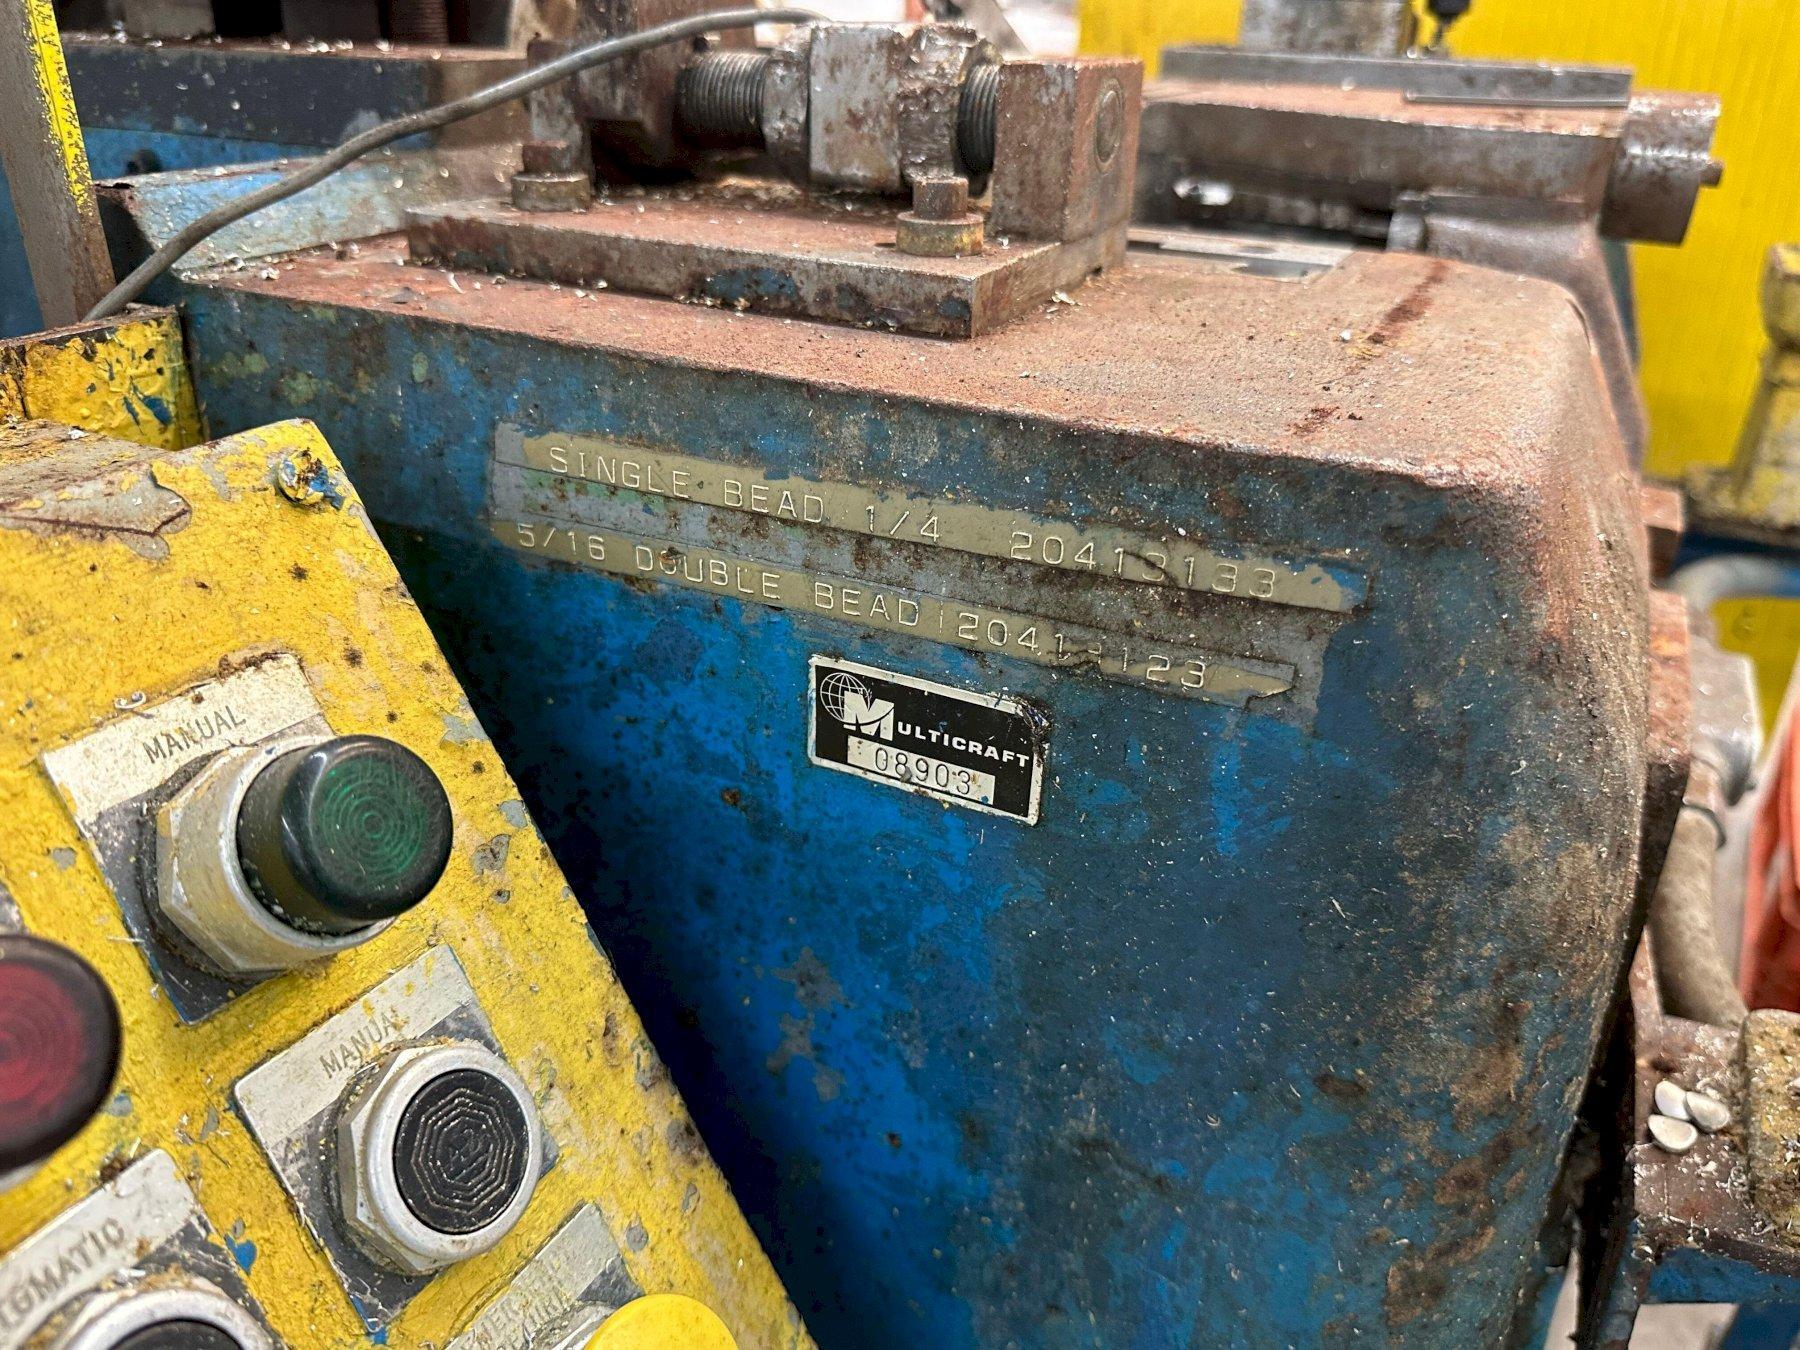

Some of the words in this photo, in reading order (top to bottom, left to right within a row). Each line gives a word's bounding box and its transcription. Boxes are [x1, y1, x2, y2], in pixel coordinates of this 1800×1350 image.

[549, 446, 692, 499] SINGLE
[723, 480, 827, 524] BEAD
[865, 504, 942, 544] 1/4
[516, 523, 606, 561] 5/16
[635, 545, 781, 600] DOUBLE
[814, 582, 920, 627] BEAD
[142, 705, 247, 764] MANUAL
[843, 690, 1030, 768] MULTICRAFT
[874, 747, 972, 796] 08903
